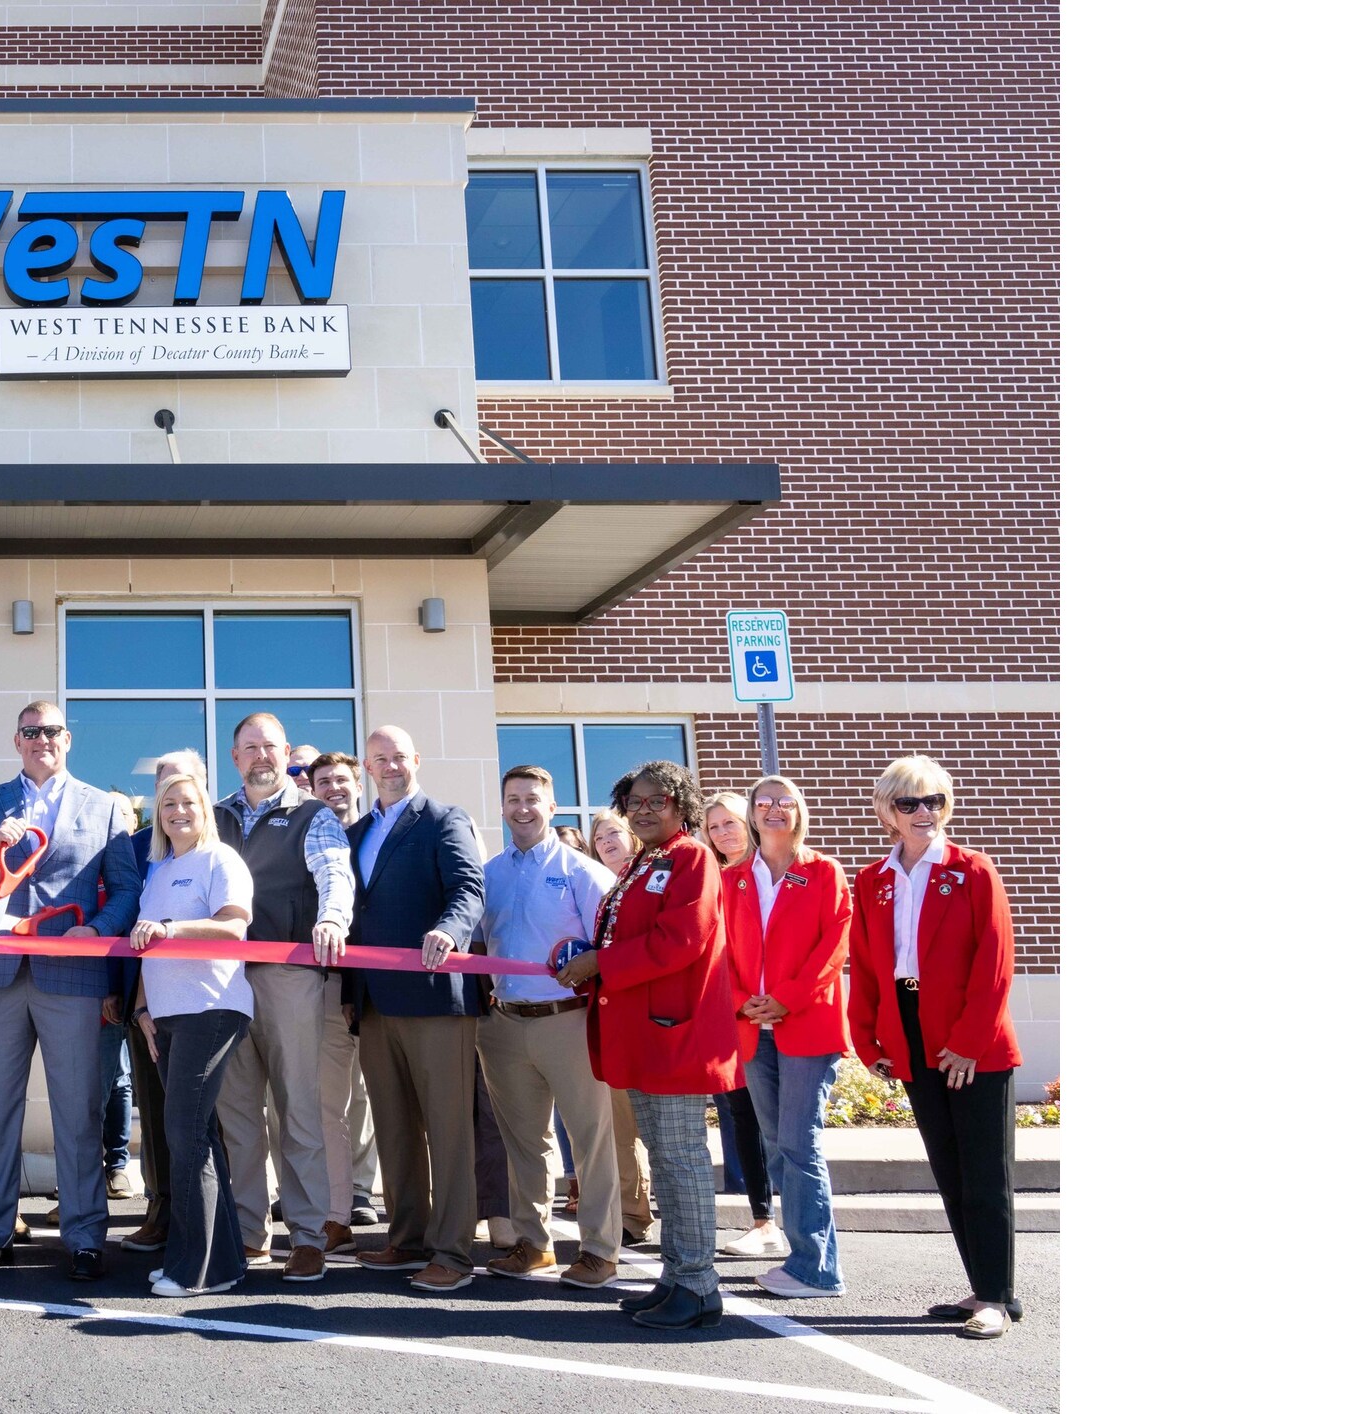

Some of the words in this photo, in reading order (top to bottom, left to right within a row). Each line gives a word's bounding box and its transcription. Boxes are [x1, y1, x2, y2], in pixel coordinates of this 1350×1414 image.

[10, 318, 82, 336] WEST
[93, 316, 249, 335] TENNESSEE
[263, 315, 338, 333] BANK
[41, 346, 59, 362] A
[65, 345, 124, 361] Division
[129, 345, 146, 365] of
[152, 345, 209, 361] Decatur
[213, 344, 264, 364] County
[269, 344, 309, 359] Bank
[731, 620, 783, 631] RESERVED
[736, 635, 781, 646] PARKING
